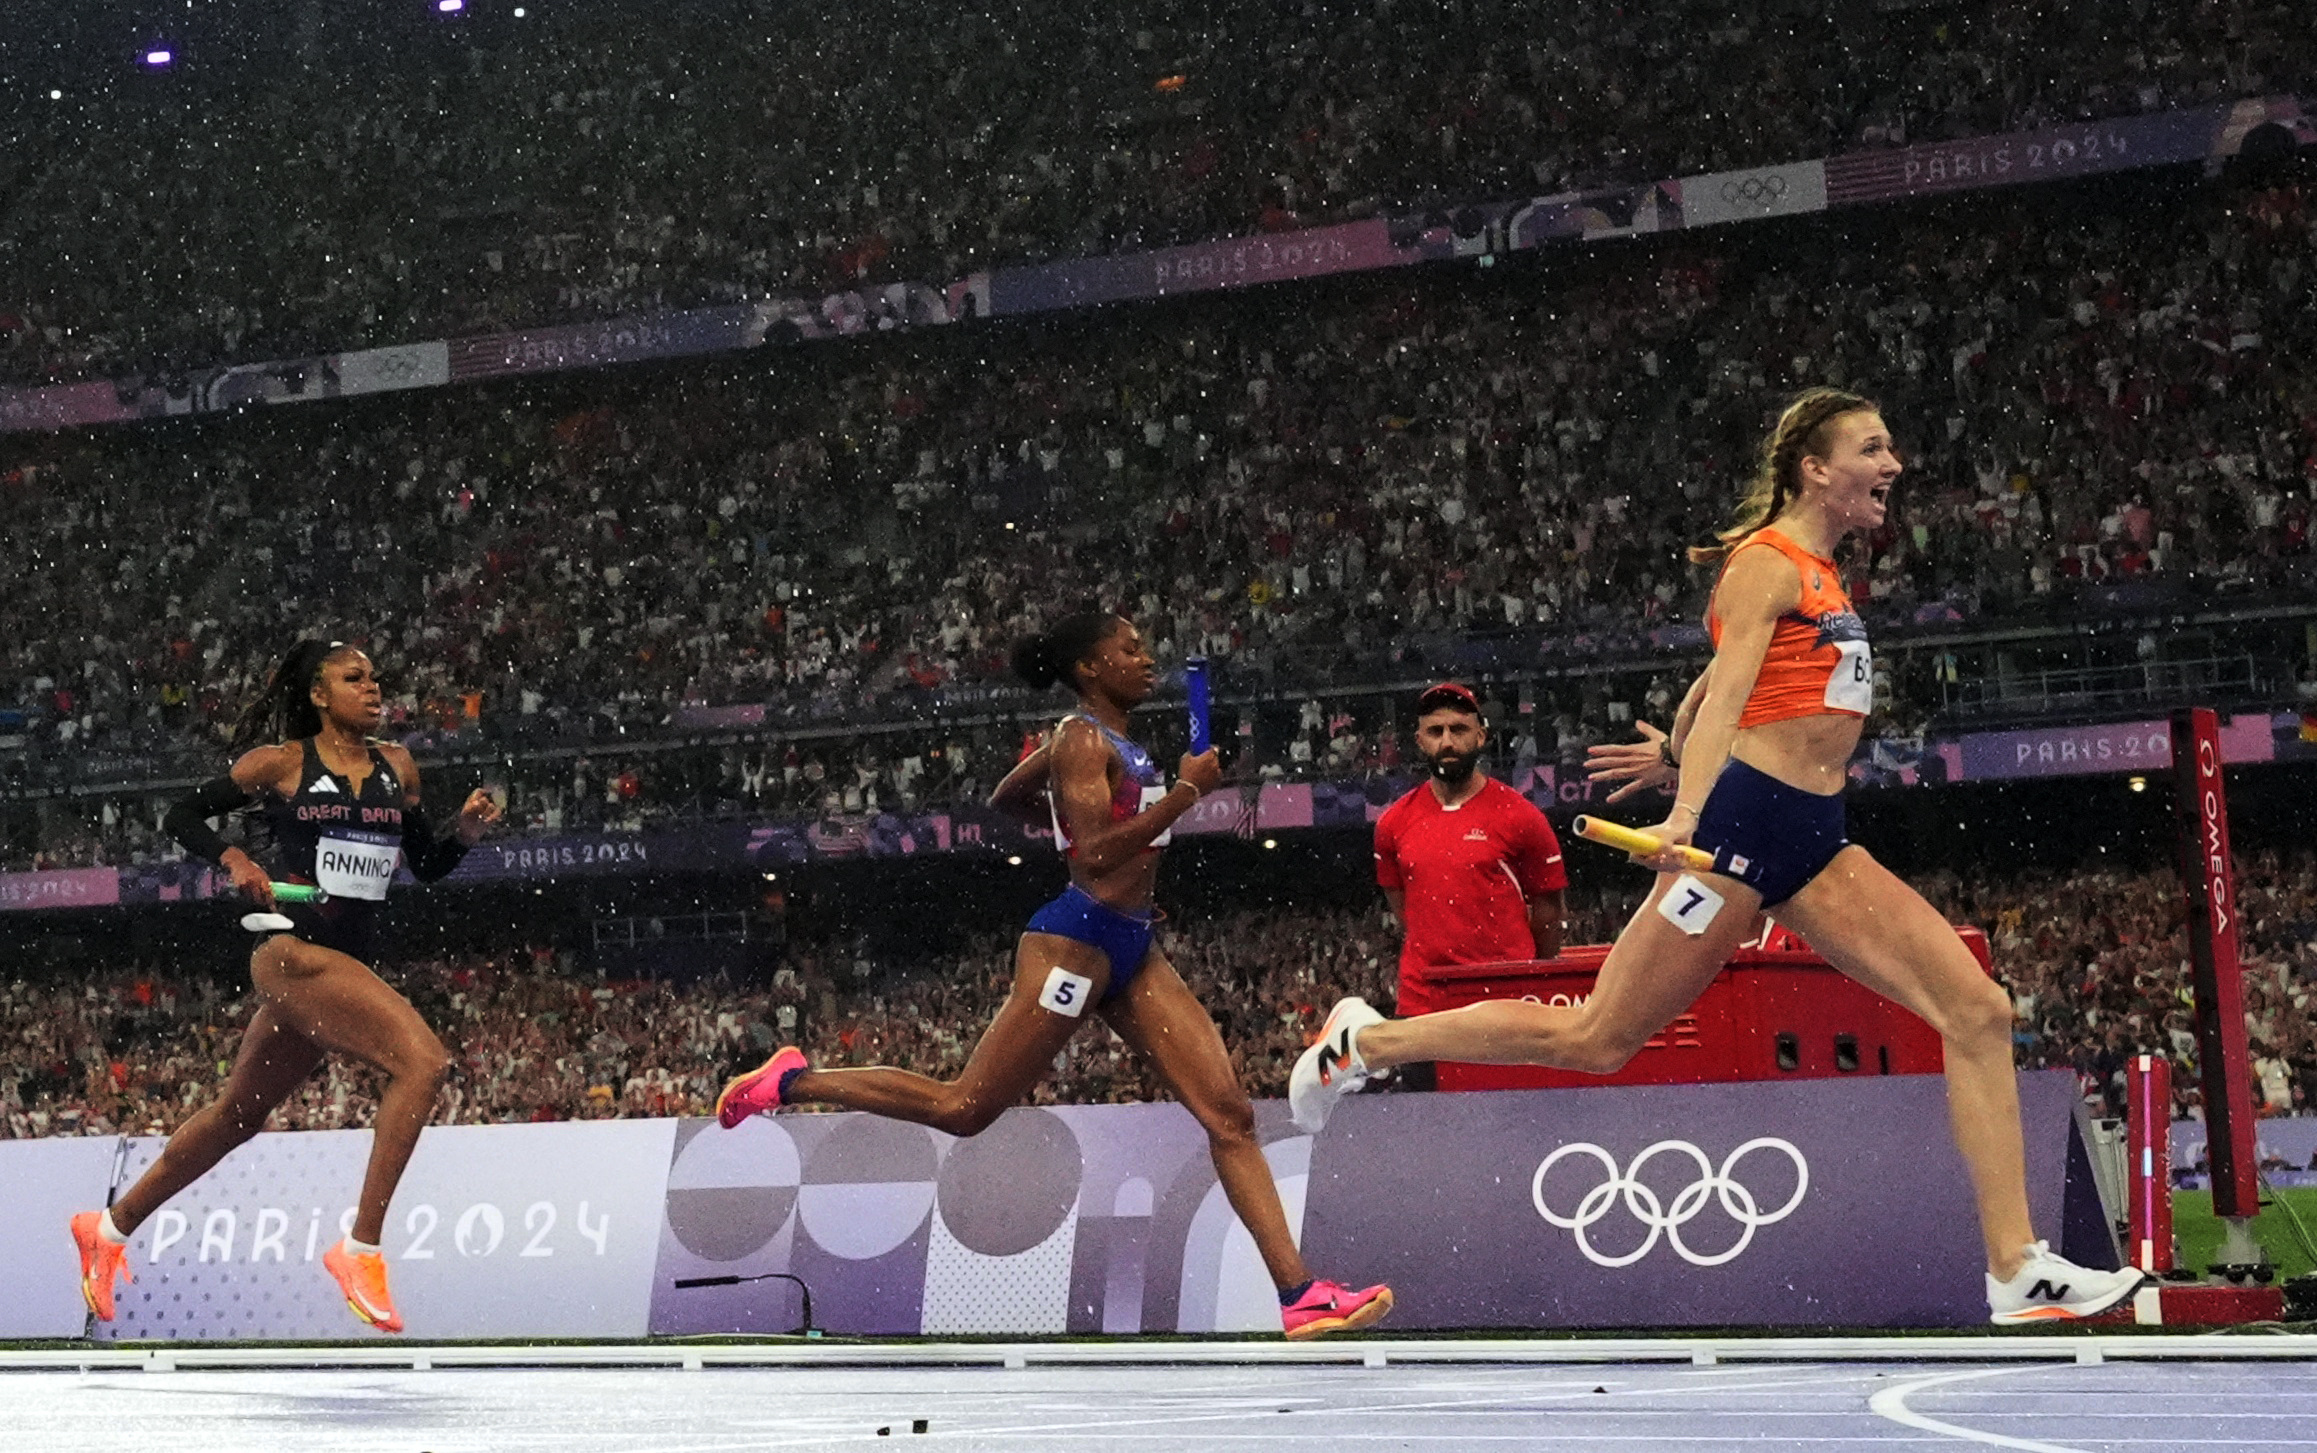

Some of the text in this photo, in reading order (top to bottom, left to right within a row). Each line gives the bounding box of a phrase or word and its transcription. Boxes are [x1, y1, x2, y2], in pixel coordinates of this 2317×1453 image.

[1904, 133, 2128, 186] PARIS 2024
[1155, 246, 1247, 284] PARIS
[506, 335, 587, 362] PARIS
[2016, 733, 2170, 765] PARIS 20
[297, 804, 351, 820] GREAT
[504, 841, 647, 869] PARIS 2024
[2204, 790, 2228, 935] OMEGA
[1677, 888, 1705, 917] 7
[1055, 981, 1075, 1005] 5
[401, 1200, 610, 1260] 2024
